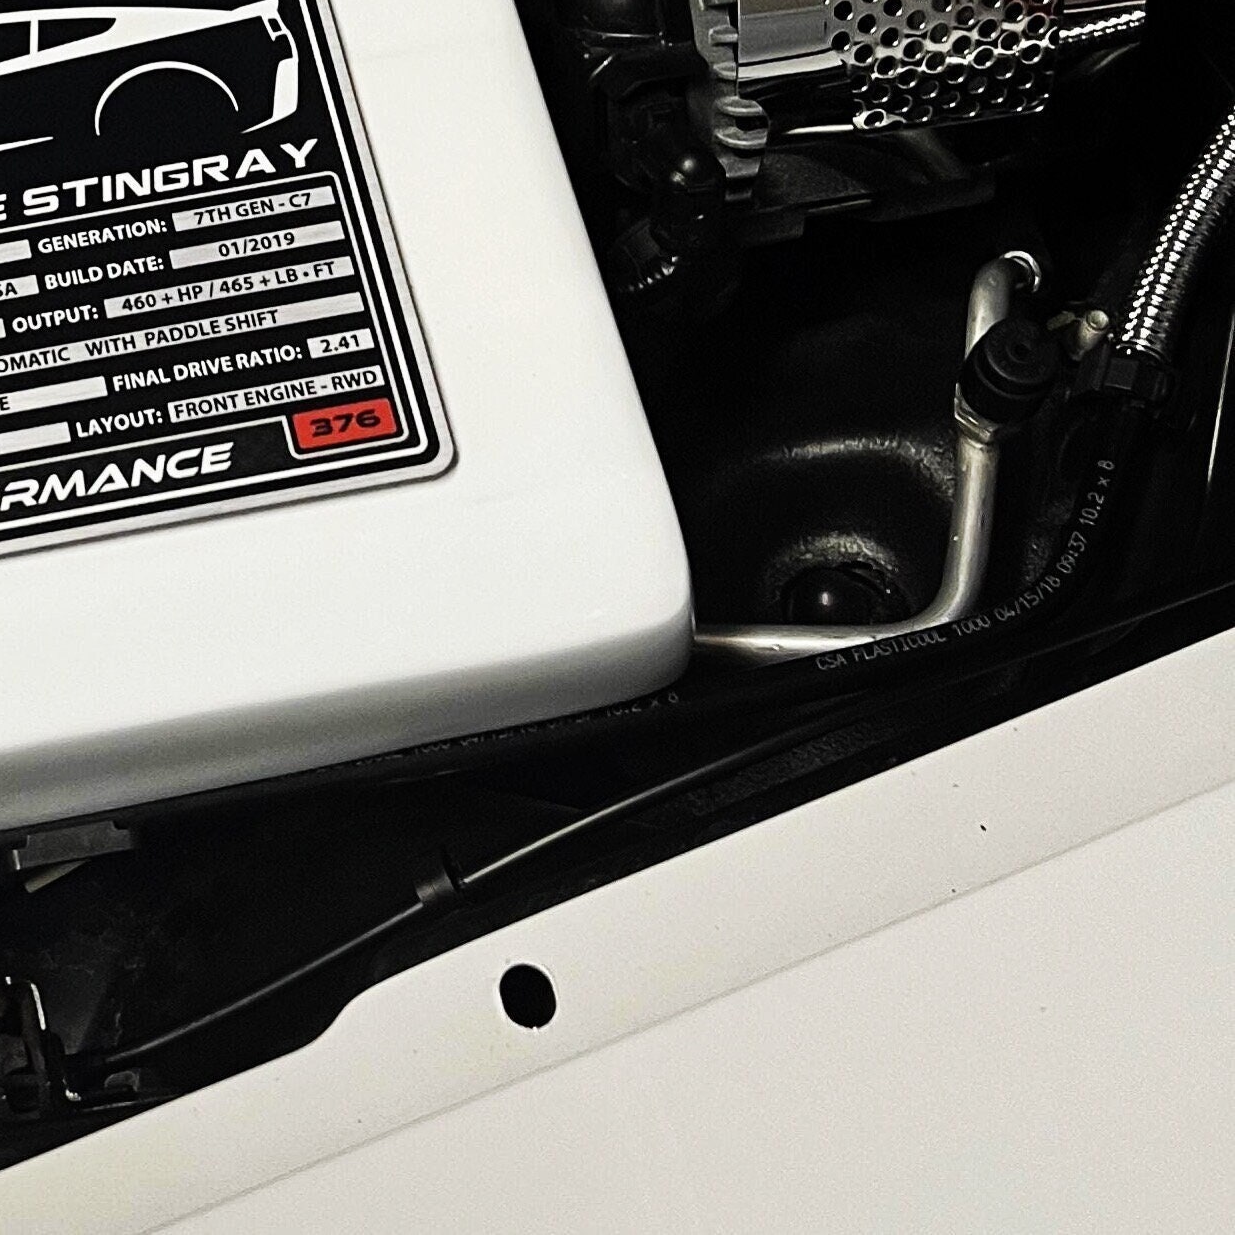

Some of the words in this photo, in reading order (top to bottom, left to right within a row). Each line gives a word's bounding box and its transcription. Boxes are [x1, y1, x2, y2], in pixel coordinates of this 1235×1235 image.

[23, 138, 318, 217] STINGRAY
[38, 218, 167, 254] GENERATION:
[194, 206, 231, 226] 7TH
[235, 200, 274, 218] GEN
[289, 192, 311, 209] C7
[45, 266, 103, 290] BUILD
[108, 256, 165, 279] DATE:
[218, 232, 296, 258] 01/2019
[12, 306, 99, 333] OUTPUT:
[122, 295, 157, 312] 460
[178, 286, 203, 303] HP
[219, 277, 254, 295] 465
[275, 267, 299, 285] LB
[314, 262, 335, 279] FT
[85, 336, 136, 357] WITH
[145, 321, 222, 347] PADDLE
[226, 309, 279, 331] SHIFT
[113, 367, 170, 392] FINAL
[174, 354, 233, 381] DRIVE
[236, 345, 303, 369] RATIO:
[320, 334, 360, 354] 2.41
[76, 410, 163, 438] LAYOUT:
[173, 395, 239, 420] FRONT
[245, 381, 316, 406] ENGINE
[332, 370, 377, 391] RWD
[309, 408, 381, 438] 376
[815, 653, 847, 671] CSA
[1079, 491, 1105, 527] 10.2
[1097, 459, 1114, 471] 8
